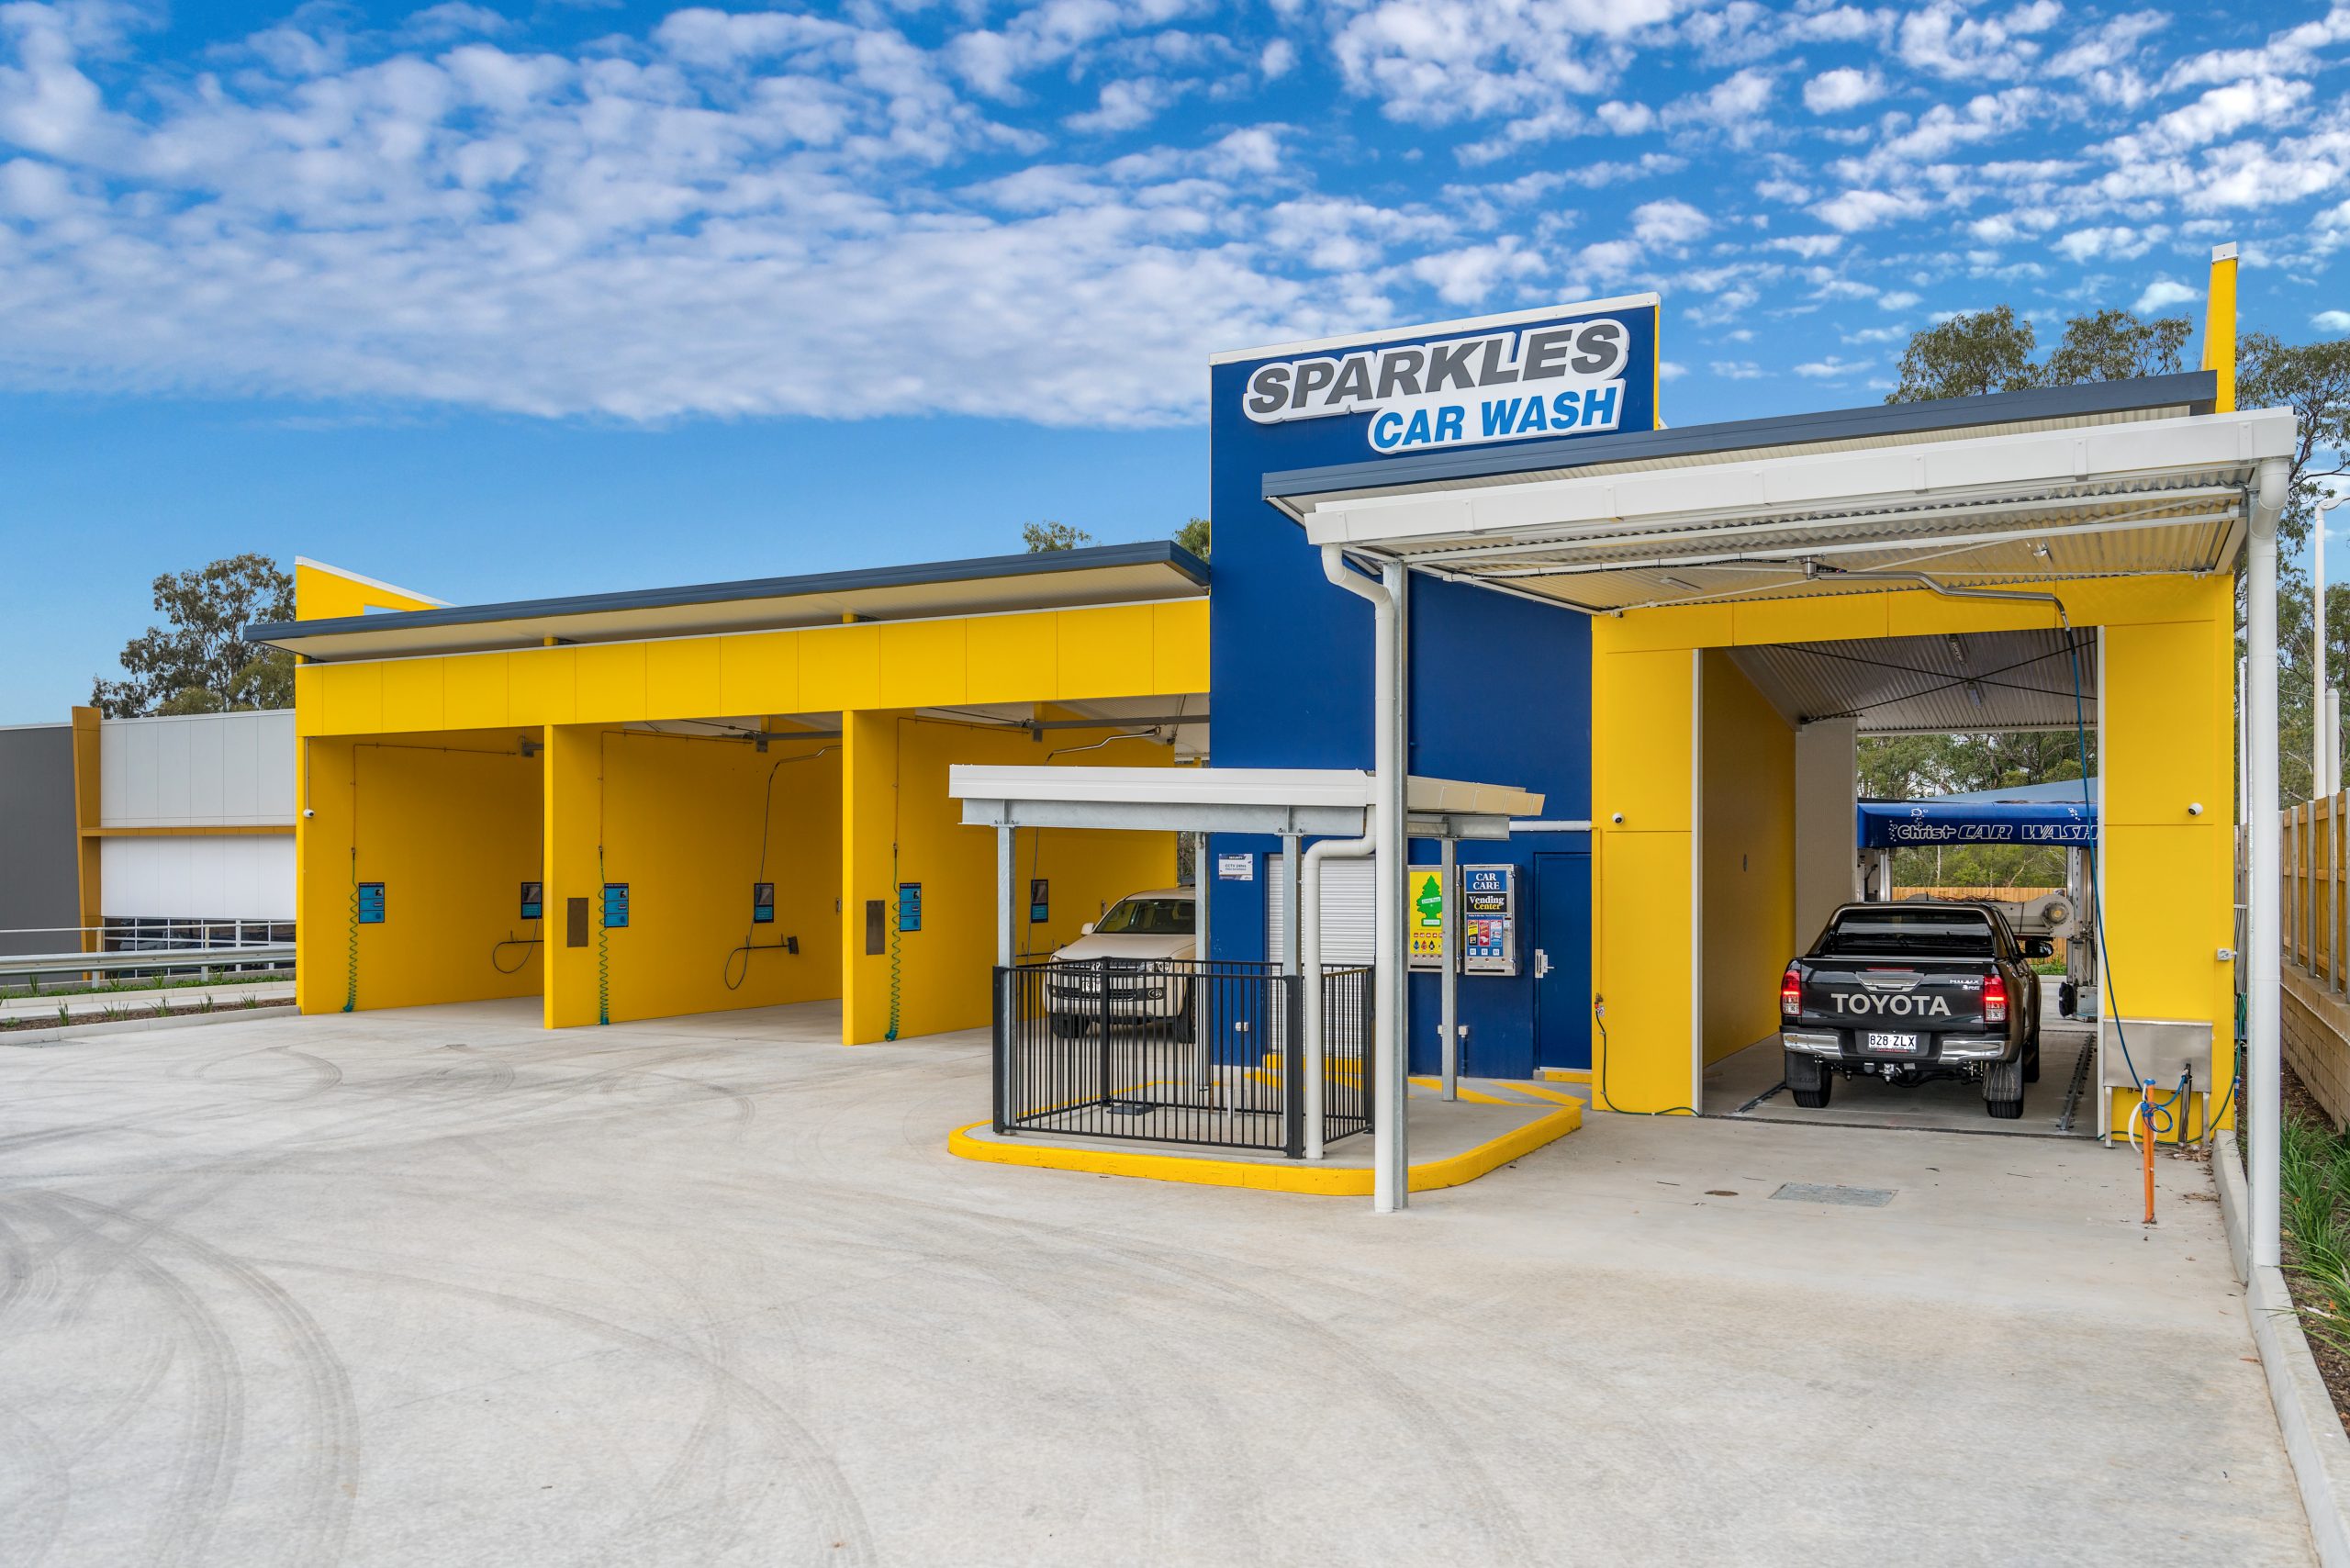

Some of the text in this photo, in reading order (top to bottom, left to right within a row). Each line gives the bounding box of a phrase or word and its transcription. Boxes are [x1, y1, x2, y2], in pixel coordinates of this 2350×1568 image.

[1248, 323, 1620, 414] SPARKLES
[1373, 386, 1617, 449] CAR WASH
[1897, 824, 2098, 840] Christ CAR WASH
[1475, 872, 1497, 881] CAR
[1472, 881, 1500, 890] CARE
[1469, 895, 1505, 906] Vending
[1830, 993, 1952, 1016] TOYOTA
[1870, 1035, 1916, 1047] 828 ZLX
